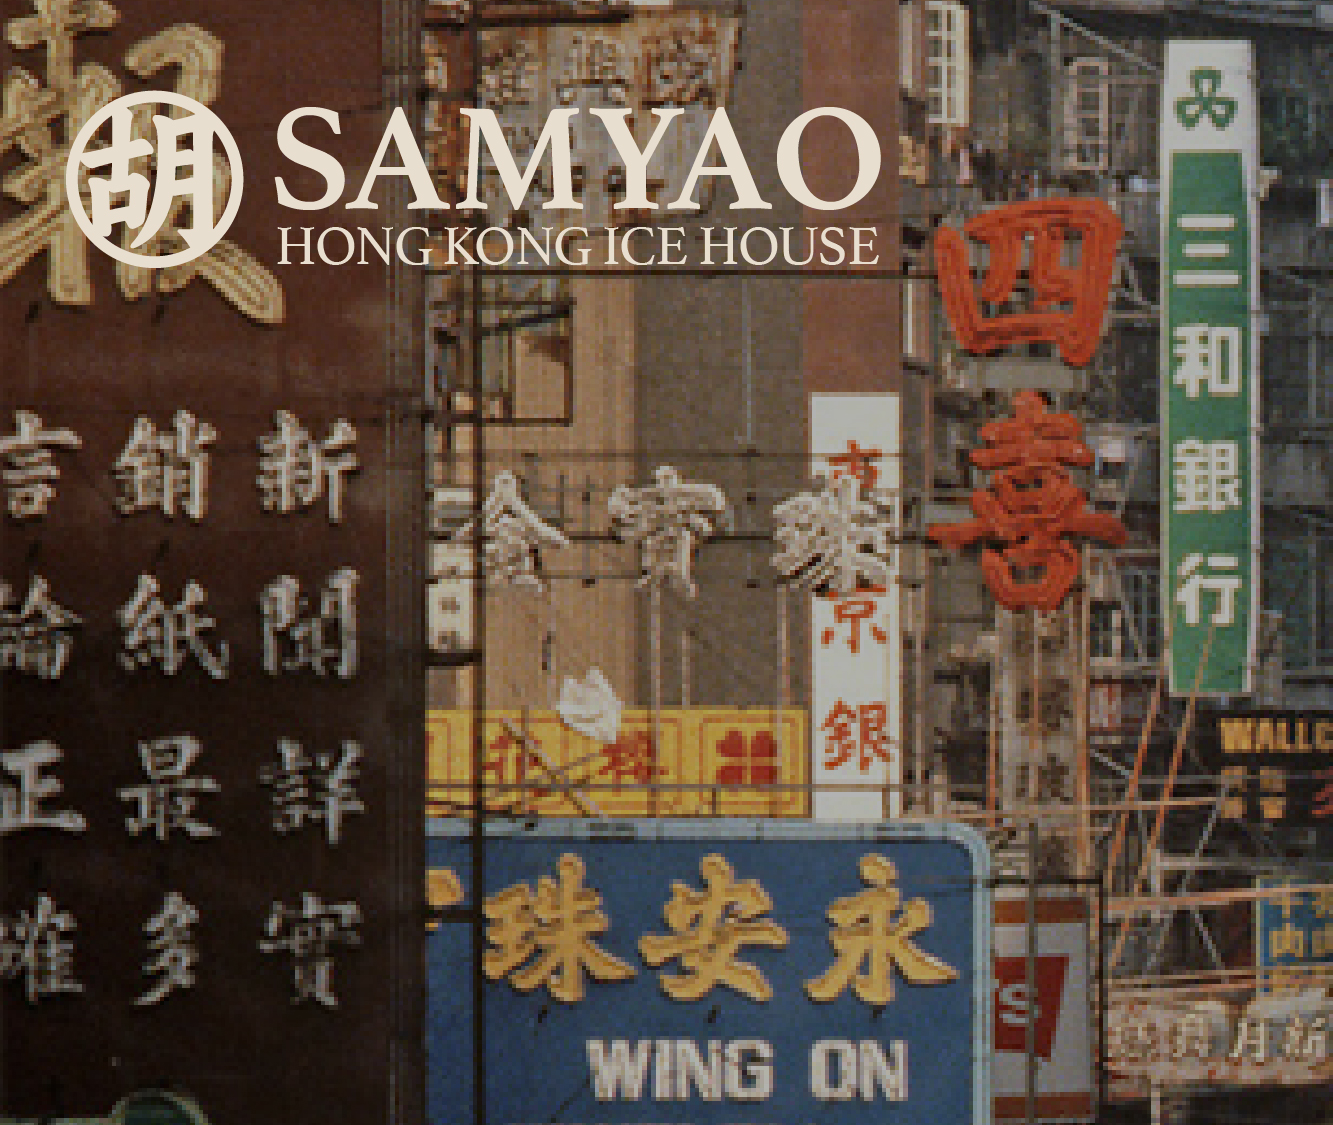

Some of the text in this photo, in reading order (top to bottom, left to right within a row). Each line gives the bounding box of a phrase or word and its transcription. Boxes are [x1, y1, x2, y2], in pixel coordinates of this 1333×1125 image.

[926, 198, 1130, 610] 四喜
[1172, 212, 1242, 628] 三和銀行
[425, 853, 960, 1005] 永安珠
[587, 1038, 912, 1103] WING ON
